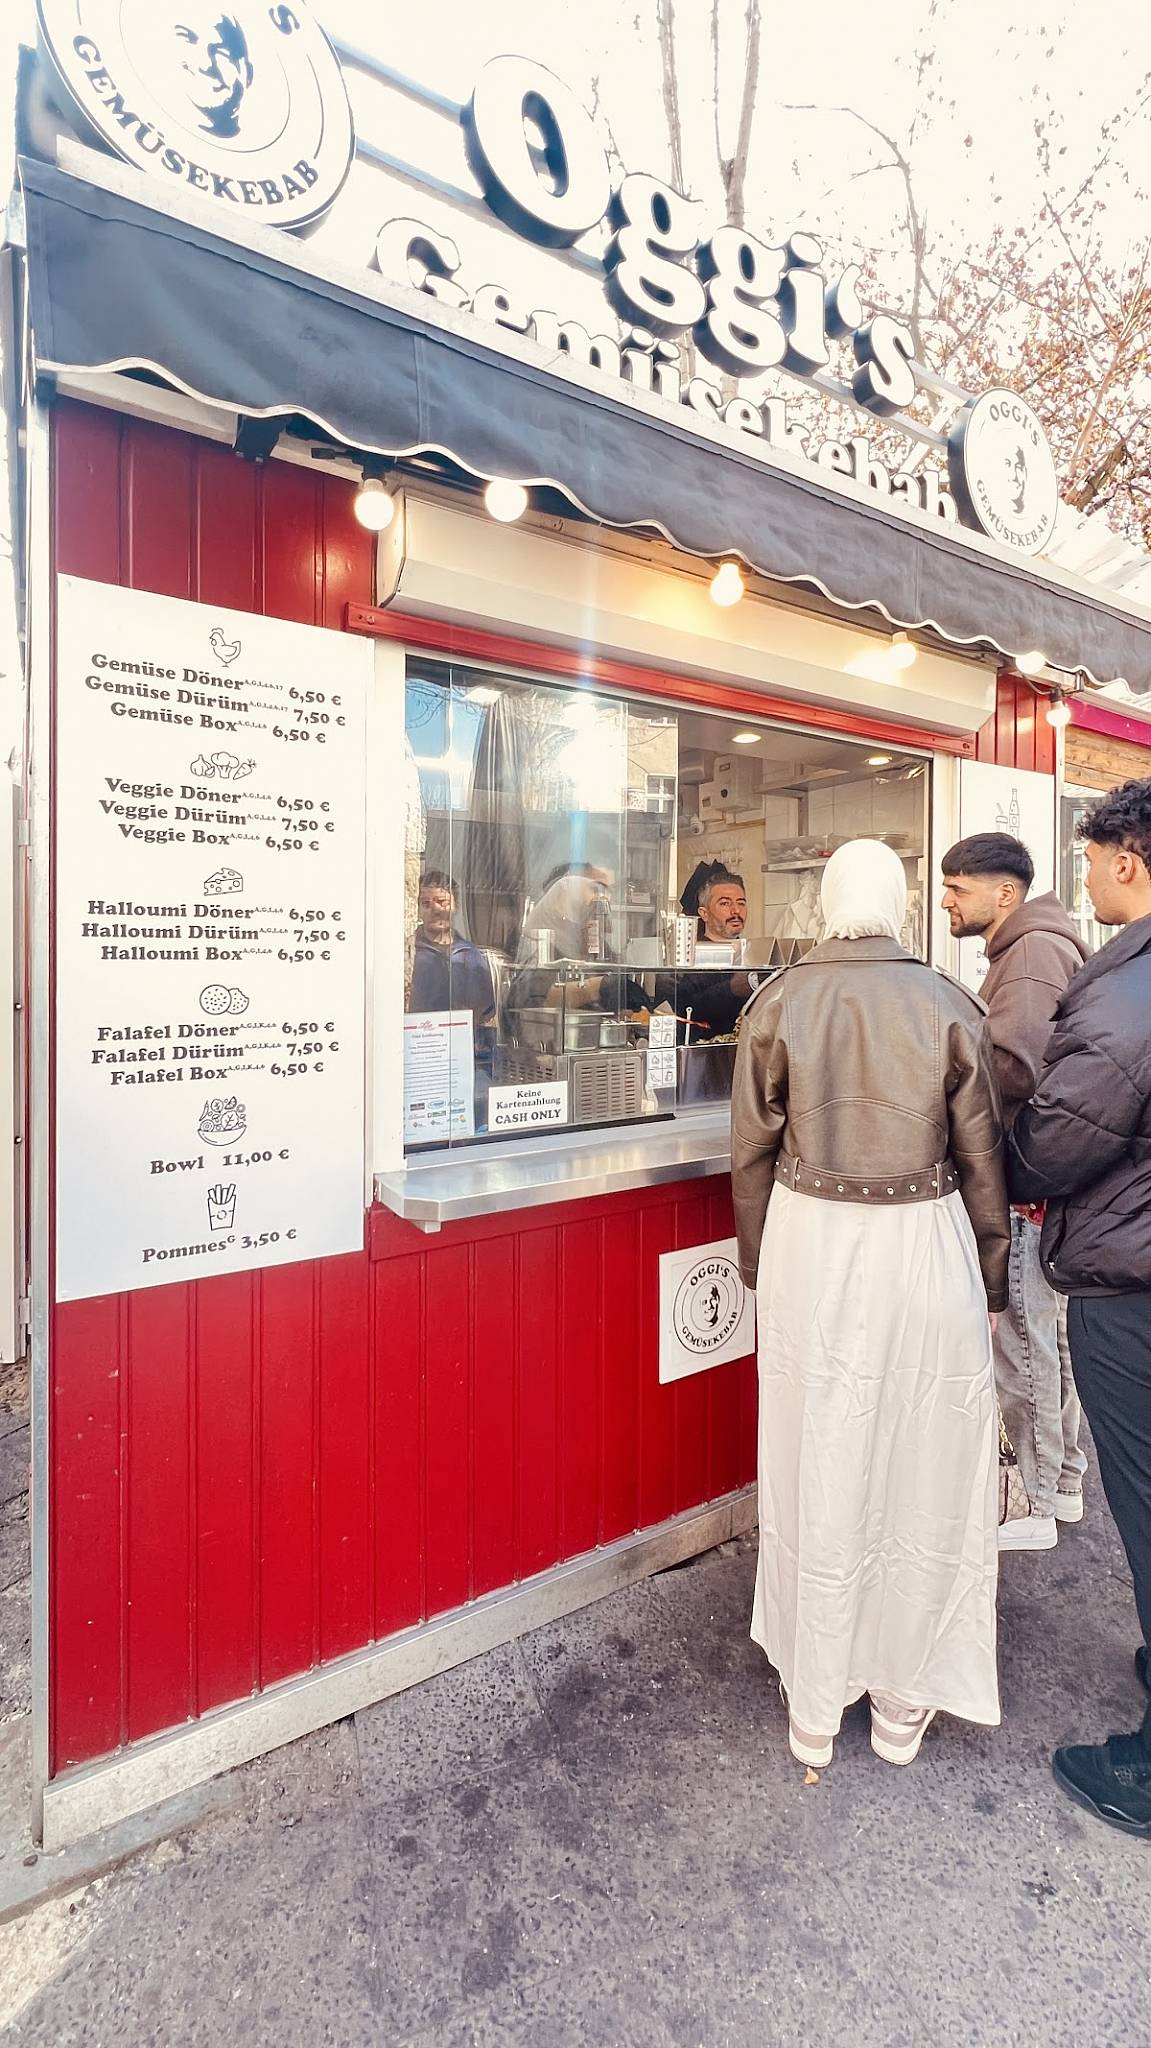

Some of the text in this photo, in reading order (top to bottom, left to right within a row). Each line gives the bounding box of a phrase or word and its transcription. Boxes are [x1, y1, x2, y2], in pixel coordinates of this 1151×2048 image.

[72, 34, 320, 206] GEMÜSEKEBAB
[463, 54, 916, 414] Oggi's
[989, 401, 1040, 446] OGGI'S
[976, 479, 1048, 547] GEMÜSEKEBAB
[92, 653, 176, 680] Gemüse
[289, 686, 325, 706] 6,50
[331, 695, 342, 706] €
[85, 675, 171, 701] Gemüse
[293, 709, 330, 725] 7,50
[336, 715, 346, 727] €
[110, 701, 194, 727] Gemüse
[272, 725, 310, 742] 6,50
[315, 732, 326, 744] €
[104, 777, 174, 800] Veggie
[276, 795, 314, 812] 6,50
[319, 801, 330, 813] €
[98, 799, 169, 821] Veggie
[281, 817, 319, 833] 7,50
[324, 821, 335, 833] €
[117, 823, 186, 845] Veggie
[265, 835, 303, 852] 6,50
[308, 840, 320, 852] €
[87, 900, 188, 918] Halloumi
[288, 908, 326, 924] 6,50
[330, 910, 342, 922] €
[81, 922, 182, 939] Halloumi
[293, 929, 330, 944] 7,50
[335, 930, 346, 942] €
[100, 945, 200, 962] Halloumi
[277, 948, 315, 964] 6,50
[320, 950, 331, 962] €
[97, 1022, 172, 1042] Falafel
[281, 1022, 319, 1037] 6,50
[323, 1021, 335, 1033] €
[90, 1044, 166, 1065] Falafel
[286, 1041, 324, 1057] 7,50
[328, 1040, 340, 1052] €
[110, 1066, 184, 1086] Falafel
[270, 1061, 308, 1078] 6,50
[312, 1061, 324, 1073] €
[496, 1096, 561, 1110] Kartenzahlung
[516, 1090, 542, 1099] Keine
[495, 1108, 562, 1125] CASH ONLY
[149, 1148, 290, 1175] Bowl 11,00 €
[240, 1231, 281, 1250] 3,50
[285, 1228, 297, 1240] €
[690, 1263, 731, 1287] OGGI'S
[682, 1311, 738, 1348] GEMÜSEKEBAB
